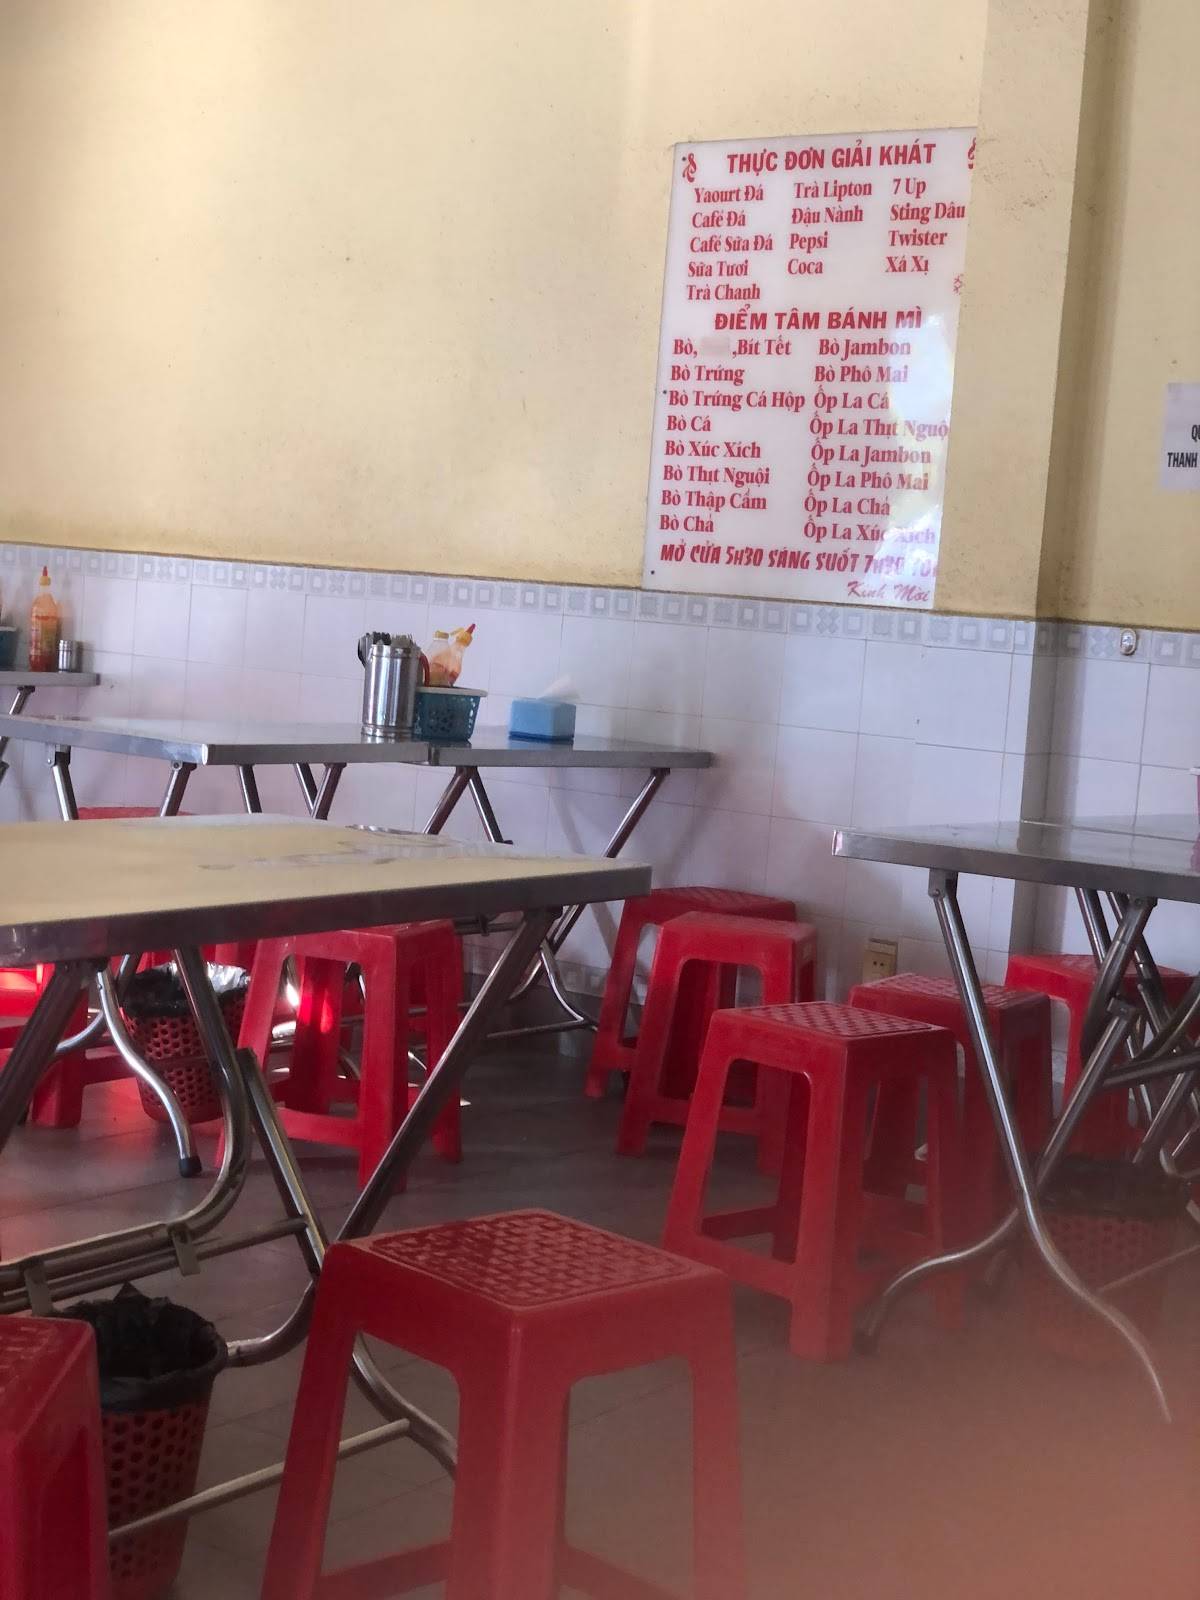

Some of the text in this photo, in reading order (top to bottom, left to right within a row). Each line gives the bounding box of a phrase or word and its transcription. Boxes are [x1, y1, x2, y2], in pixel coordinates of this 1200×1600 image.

[728, 139, 936, 176] THỰC ĐƠN GIẢI KHÁT
[694, 184, 764, 203] Yaourt Đá
[795, 180, 872, 200] Trà Lipton
[893, 178, 926, 198] 7 Up
[692, 210, 746, 228] Café Đá
[792, 205, 863, 227] Đậu Nành
[890, 201, 965, 224] Sting Dâu
[690, 234, 773, 253] Café Sữa Đá
[789, 231, 828, 253] Pepsi
[889, 230, 947, 246] Twister
[688, 259, 748, 276] Sữa Tươi
[788, 259, 823, 275] Coca
[886, 255, 928, 275] Xá Xị
[687, 284, 760, 300] Trà Chanh
[715, 304, 921, 330] ĐIỂM TÂM BÁNH MÌ
[673, 338, 698, 358] Bò,
[765, 334, 791, 355] Tết
[819, 339, 910, 360] Bò Jambon
[671, 365, 744, 385] Bò Trứng
[815, 366, 908, 382] Bò Phô Mai
[669, 390, 805, 412] Bò Trứng Cá Hộp
[814, 385, 889, 412] Ốp La Cá
[667, 415, 711, 432] Bò Cá
[810, 411, 833, 439] Ốp
[838, 419, 858, 435] La
[864, 419, 898, 439] Thịt
[665, 440, 761, 458] Bò Xúc Xích
[811, 437, 931, 467] Ốp La Jambon
[1167, 452, 1198, 467] THANH
[663, 465, 770, 487] Bò Thịt Nguội
[808, 463, 928, 491] Ốp La Phô Mai
[662, 488, 766, 512] Bò Thập Cẩm
[804, 490, 827, 516] Ốp
[833, 499, 853, 514] La
[660, 515, 679, 531] Bò
[804, 515, 827, 543] Ốp
[832, 524, 851, 539] La
[661, 539, 686, 561] MỞ
[690, 540, 721, 564] CỬA
[726, 546, 763, 566] 5H30
[768, 547, 811, 569] SÁNG
[816, 548, 859, 572] SUỐT
